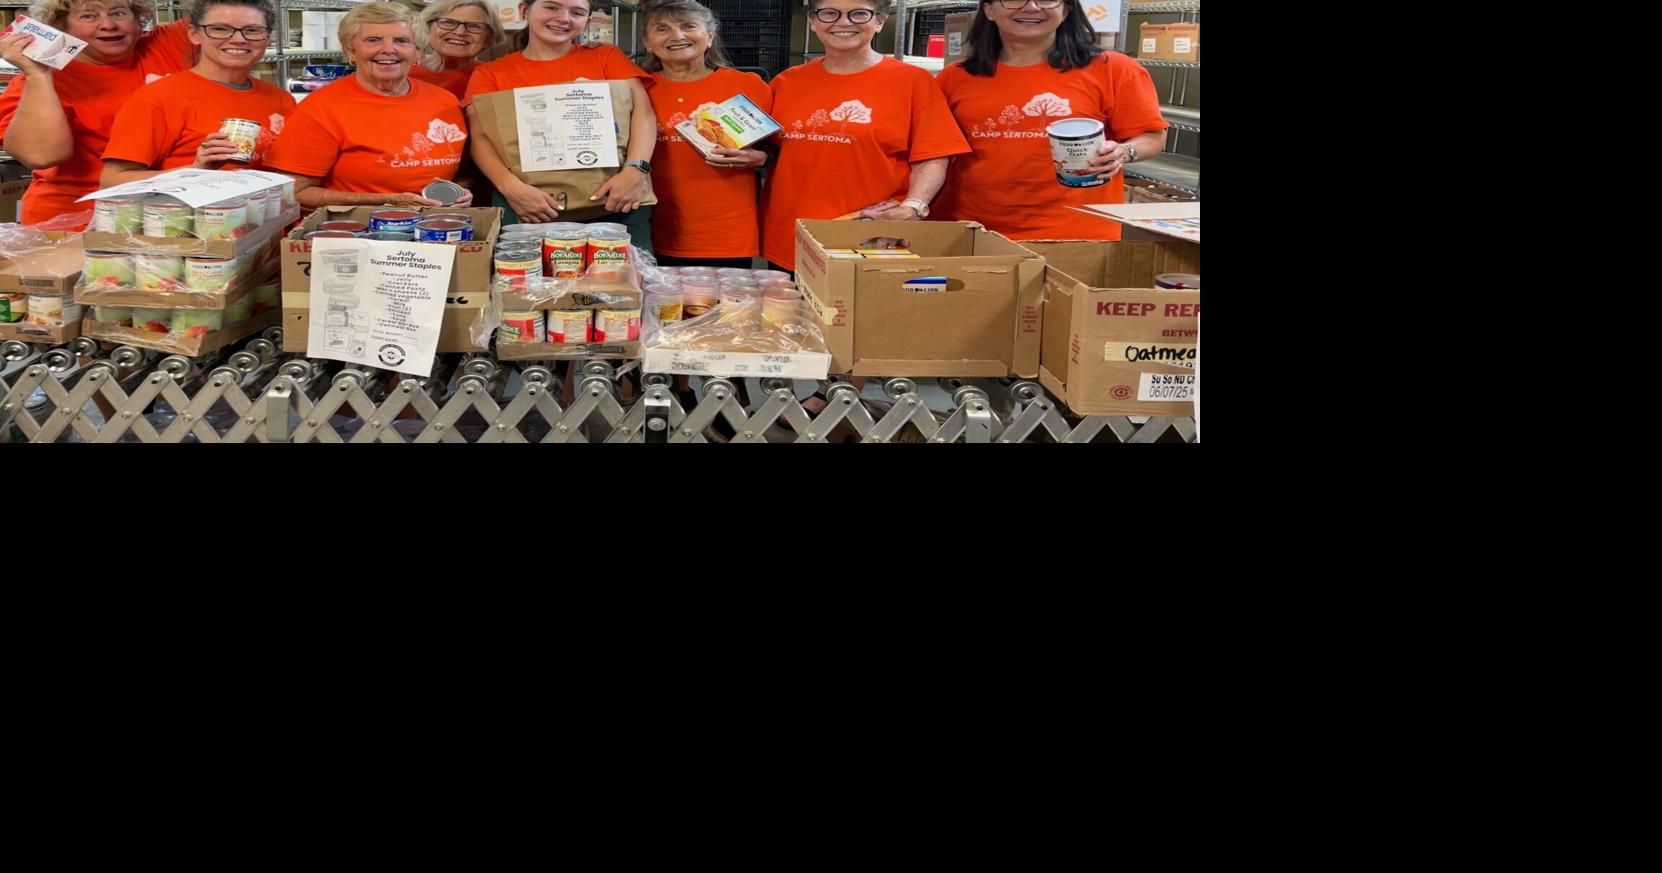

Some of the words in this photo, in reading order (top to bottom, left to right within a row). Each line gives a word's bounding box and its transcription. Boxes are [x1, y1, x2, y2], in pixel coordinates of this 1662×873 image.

[807, 134, 851, 144] SERTOMA
[972, 131, 1001, 139] CAMP
[390, 160, 420, 168] CAMP
[370, 258, 407, 267] Summer
[408, 262, 442, 270] Staples
[386, 255, 425, 263] Sertoma
[1096, 301, 1156, 316] KEEP
[1149, 385, 1188, 398] 06/07/25
